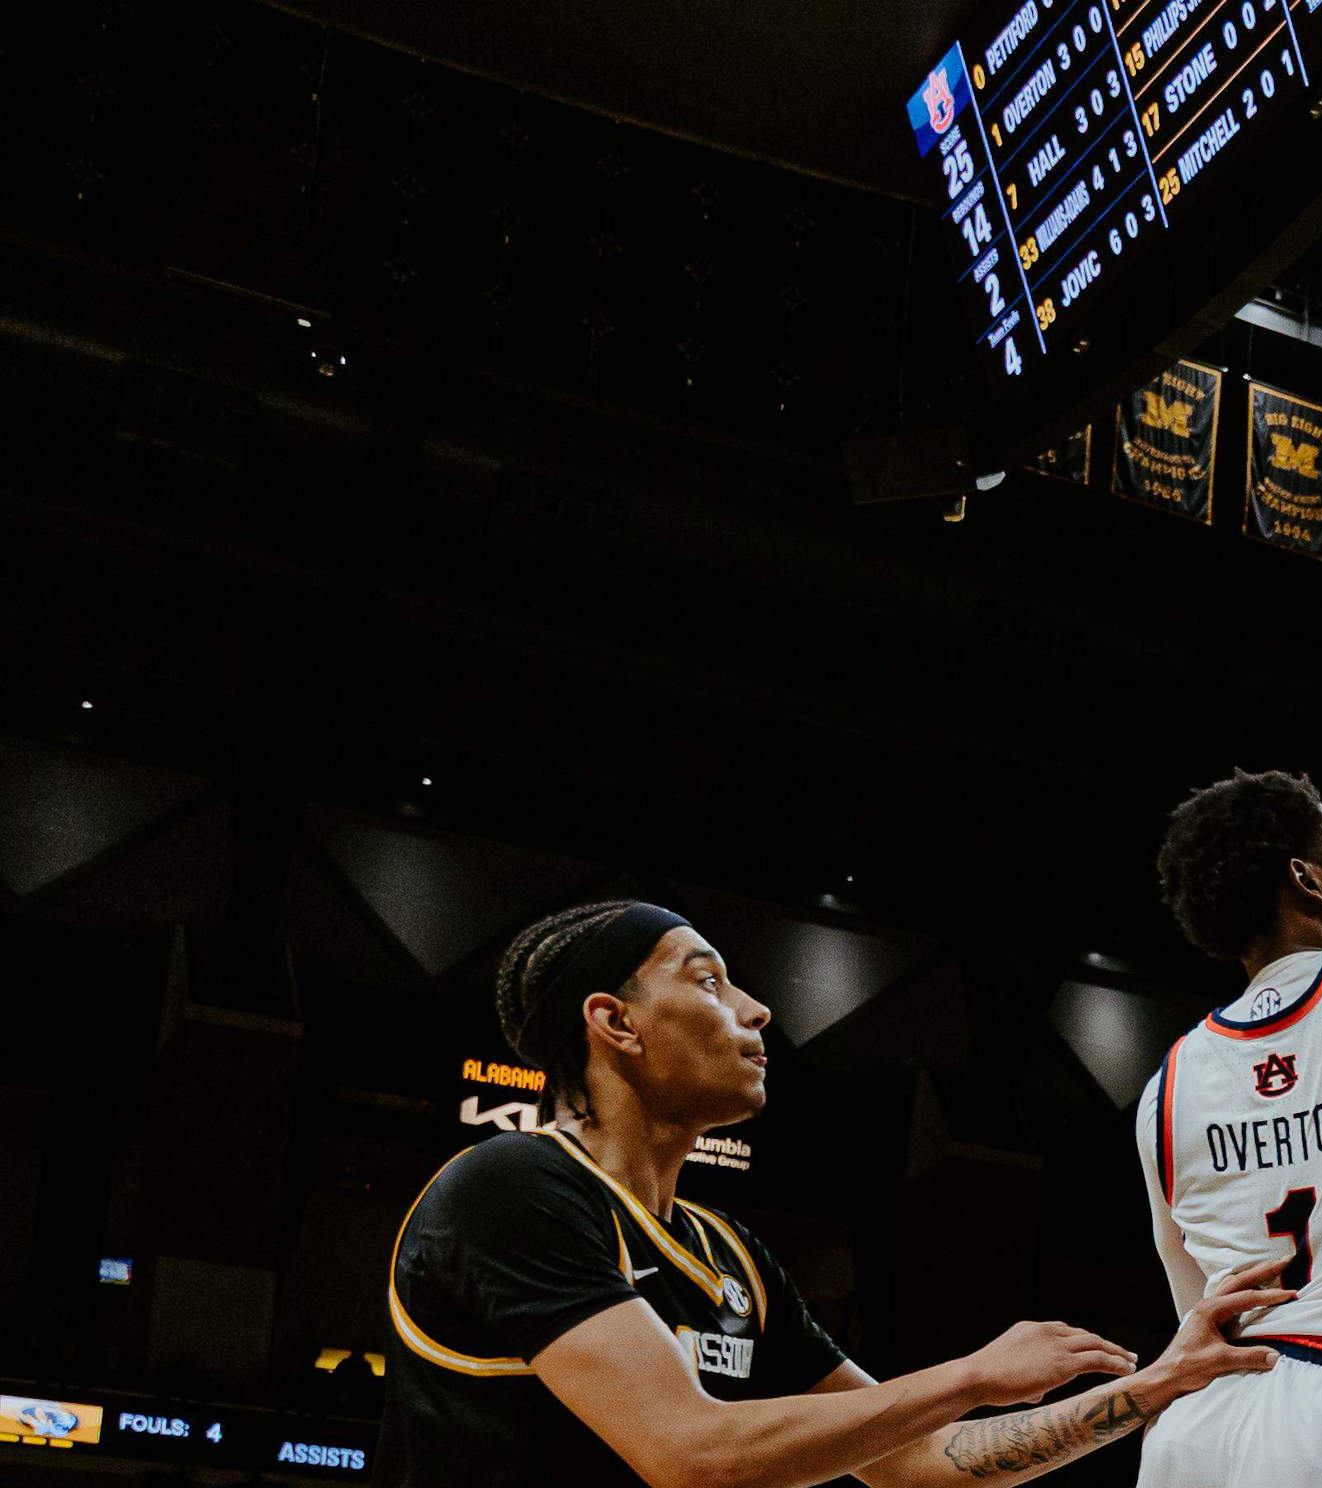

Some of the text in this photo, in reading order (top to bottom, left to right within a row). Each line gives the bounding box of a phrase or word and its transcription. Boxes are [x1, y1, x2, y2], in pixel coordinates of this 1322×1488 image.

[973, 64, 985, 89] 0
[991, 6, 1102, 146] 1 OVERTON 3 0 0
[1125, 42, 1145, 77] 15
[1142, 2, 1256, 136] 17 STONE 0 0
[1026, 134, 1066, 187] HALL
[1074, 106, 1088, 133] 3
[1090, 89, 1103, 115] 0
[1106, 70, 1120, 97] 3
[1159, 49, 1294, 205] 25 MITCHELL 2 0 1
[943, 140, 973, 199] 25
[1019, 237, 1039, 270] 33
[1092, 165, 1104, 190] 4
[1109, 148, 1120, 172] 1
[1123, 130, 1137, 157] 3
[962, 203, 992, 256] 14
[1036, 195, 1155, 331] 38 JOVIC 6 0 3
[985, 273, 1005, 317] 2
[1004, 336, 1022, 375] 4
[462, 1058, 546, 1092] ALABAMA
[695, 1135, 751, 1157] lumbia
[1265, 1186, 1318, 1290] 1
[119, 1412, 223, 1443] FOULS: 4
[277, 1441, 365, 1470] ASSISTS
